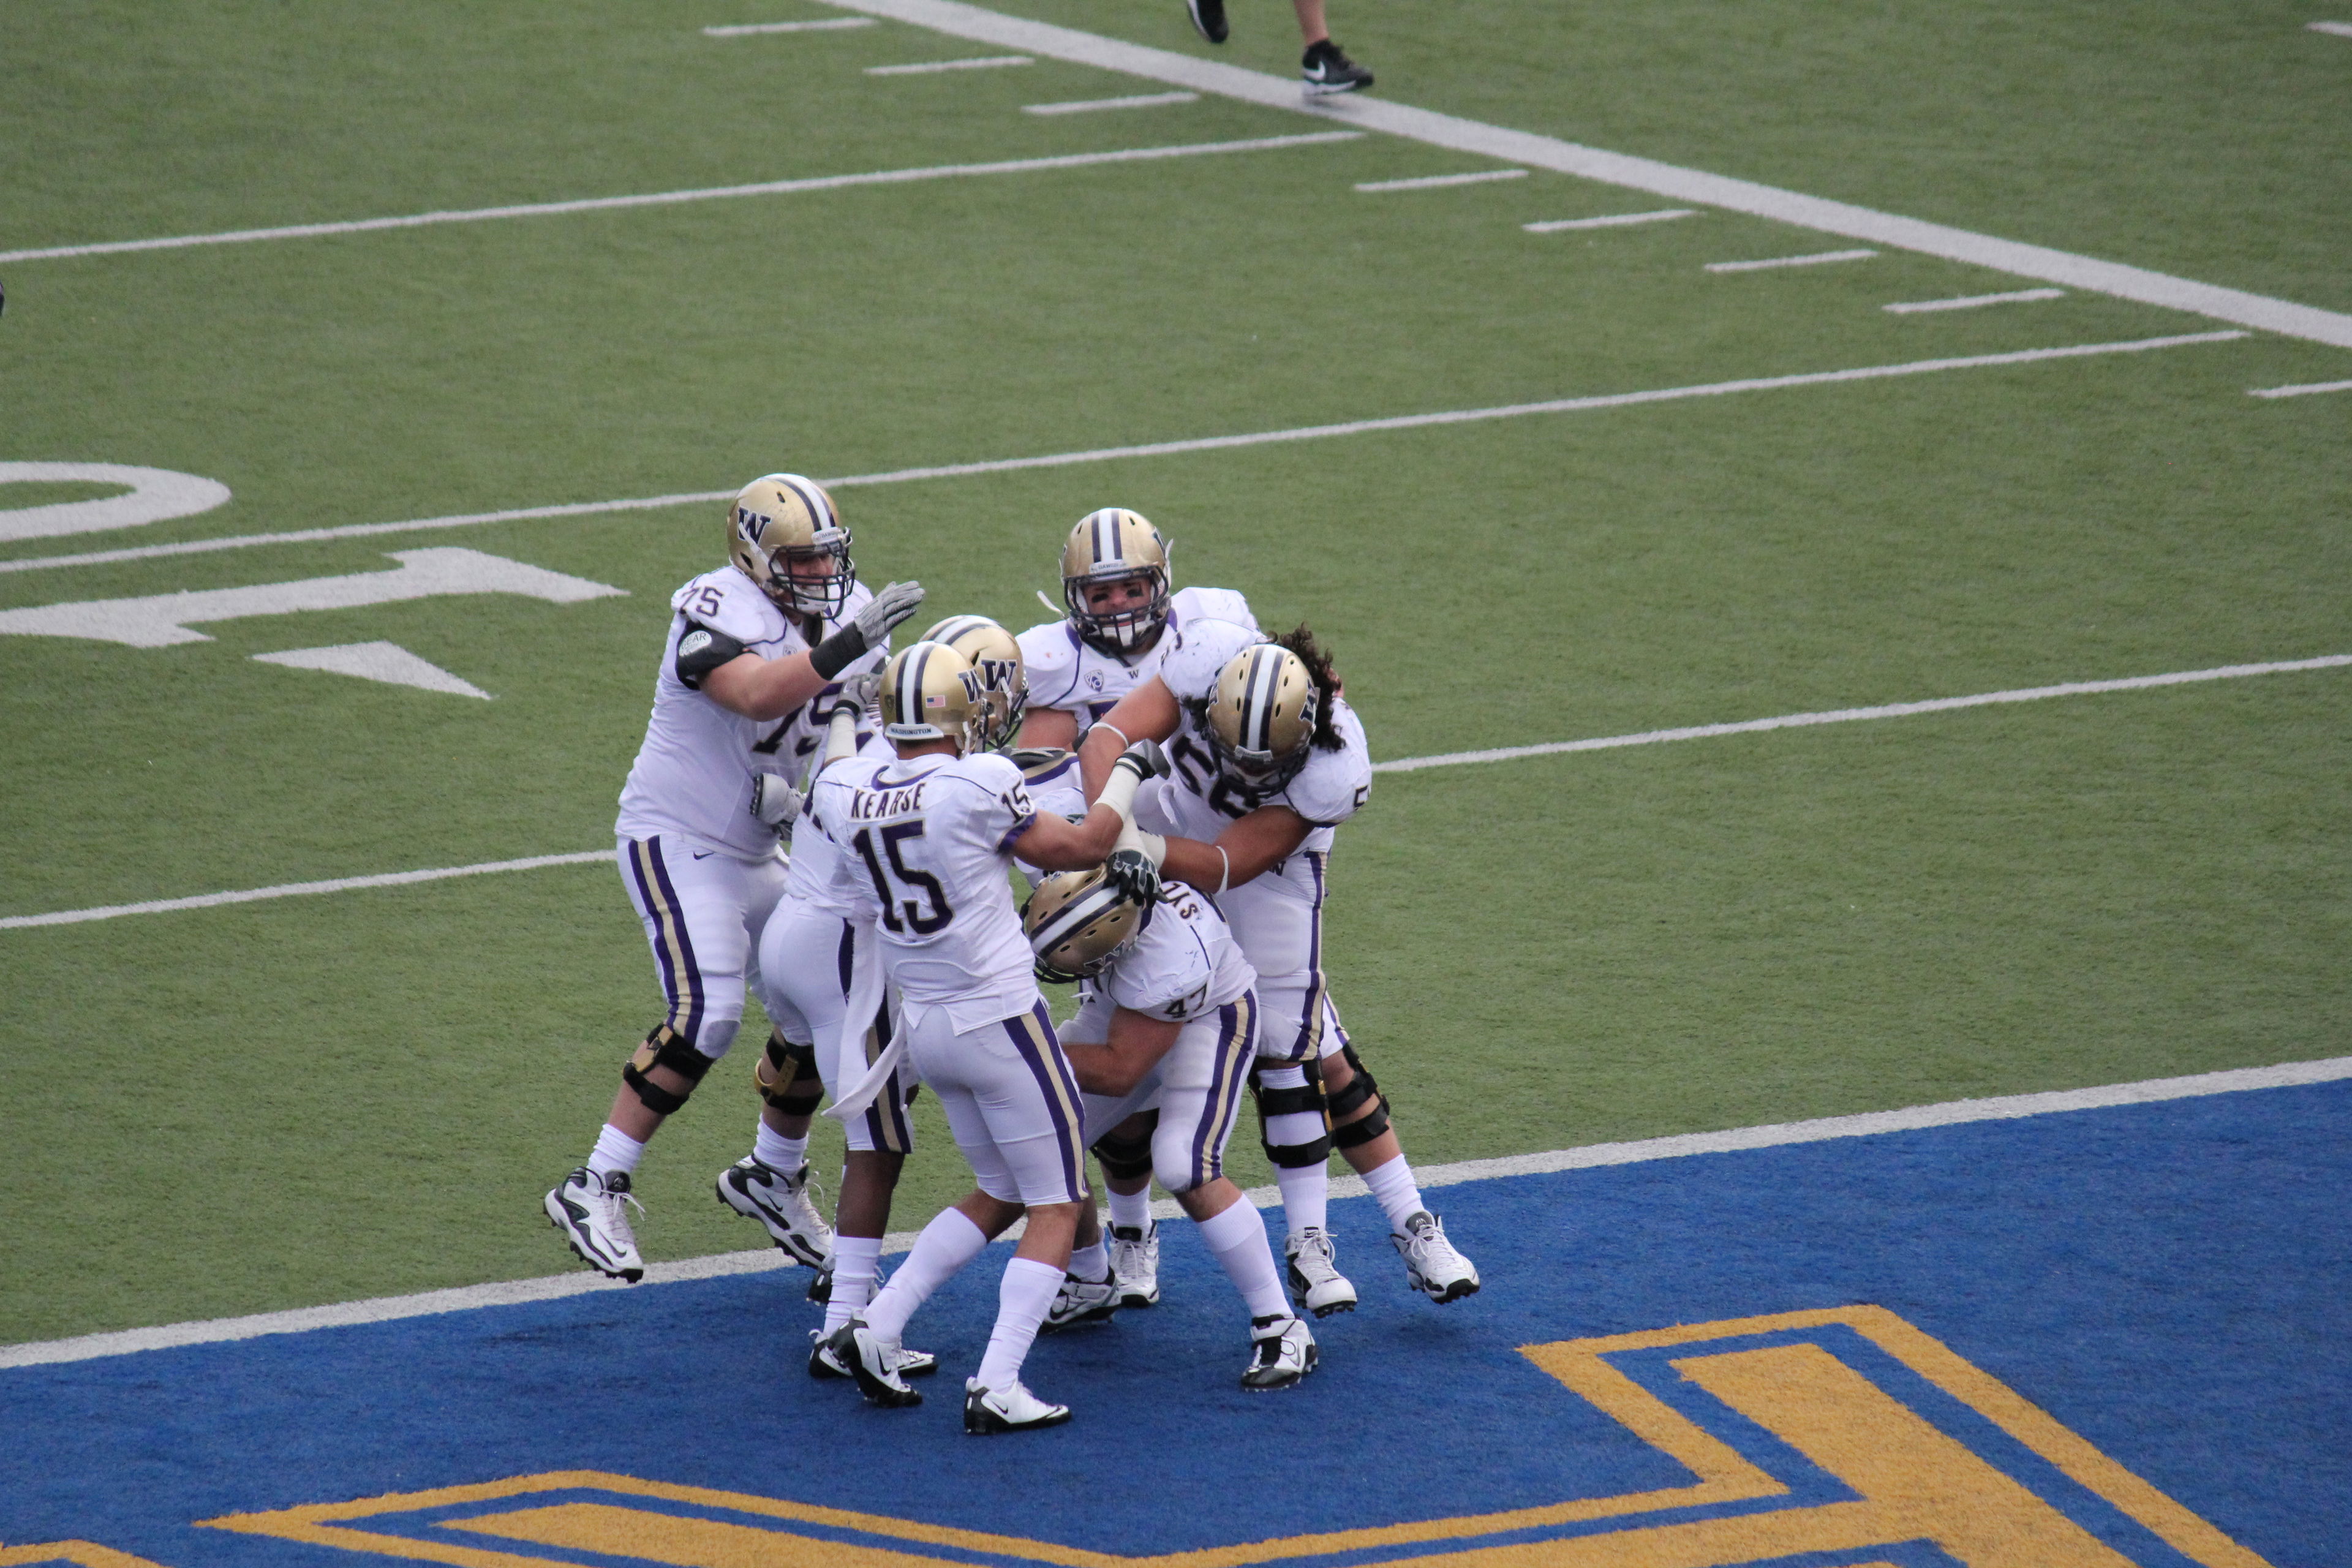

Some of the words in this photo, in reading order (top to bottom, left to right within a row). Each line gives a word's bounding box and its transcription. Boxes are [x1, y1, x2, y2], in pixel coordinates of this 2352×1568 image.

[737, 506, 772, 545] W
[679, 586, 724, 617] 75
[980, 659, 1017, 692] W
[1128, 669, 1139, 679] W
[890, 727, 932, 736] WASHINGTON
[850, 782, 928, 819] KEARSE
[1001, 780, 1033, 824] 15
[852, 817, 956, 935] 15
[1164, 981, 1209, 1019] 47
